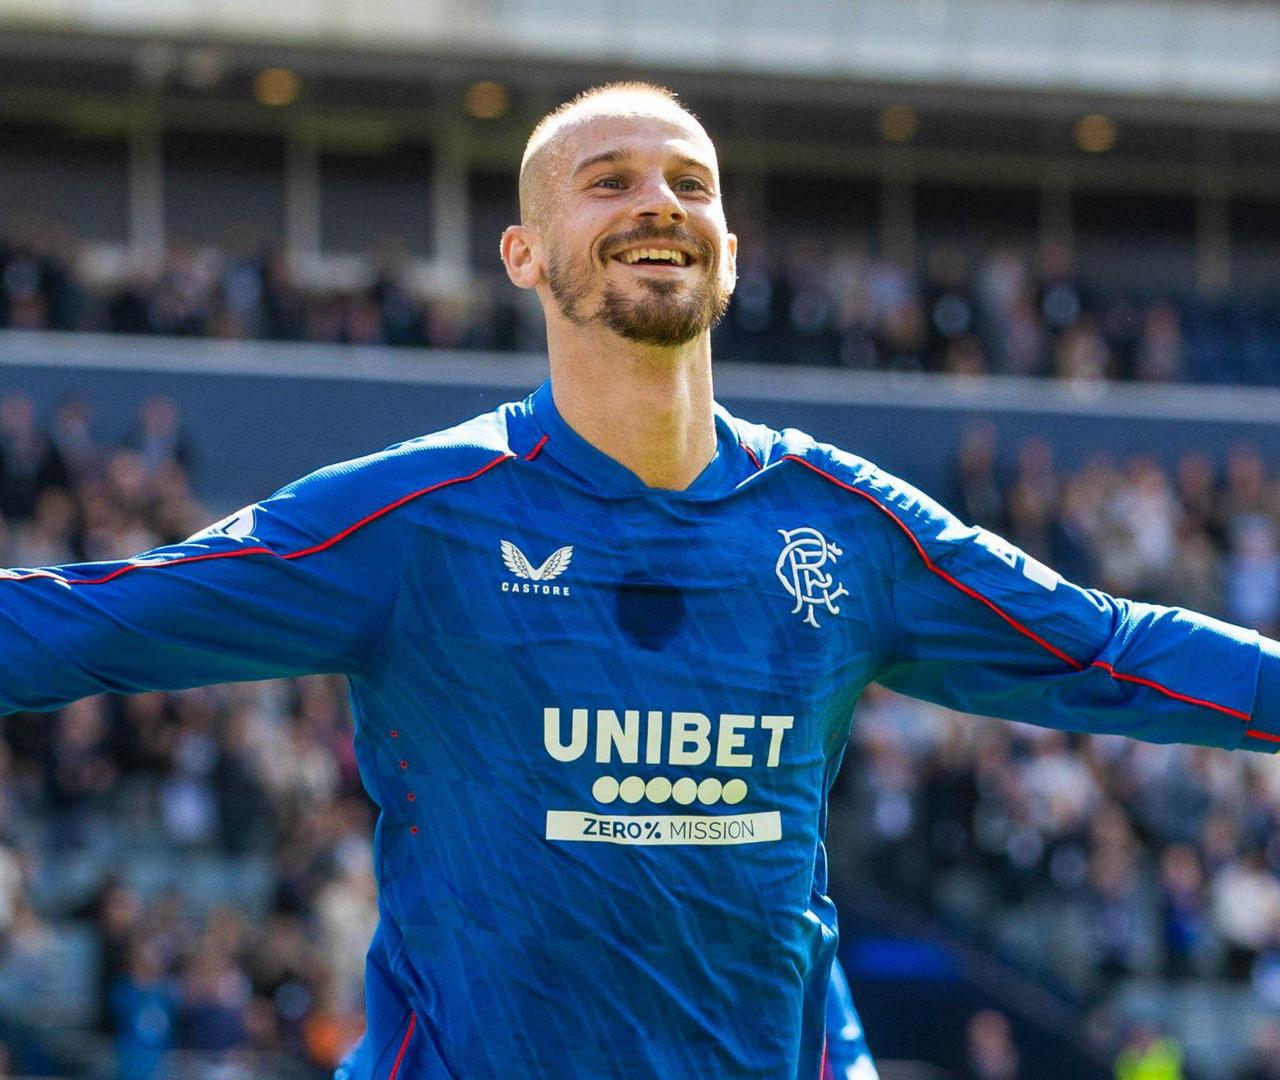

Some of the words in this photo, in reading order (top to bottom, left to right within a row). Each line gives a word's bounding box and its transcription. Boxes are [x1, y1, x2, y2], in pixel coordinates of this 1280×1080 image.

[501, 581, 571, 597] CASTORE
[543, 707, 795, 768] UNIBET
[582, 816, 662, 840] ZERO%
[669, 819, 755, 841] MISSION
